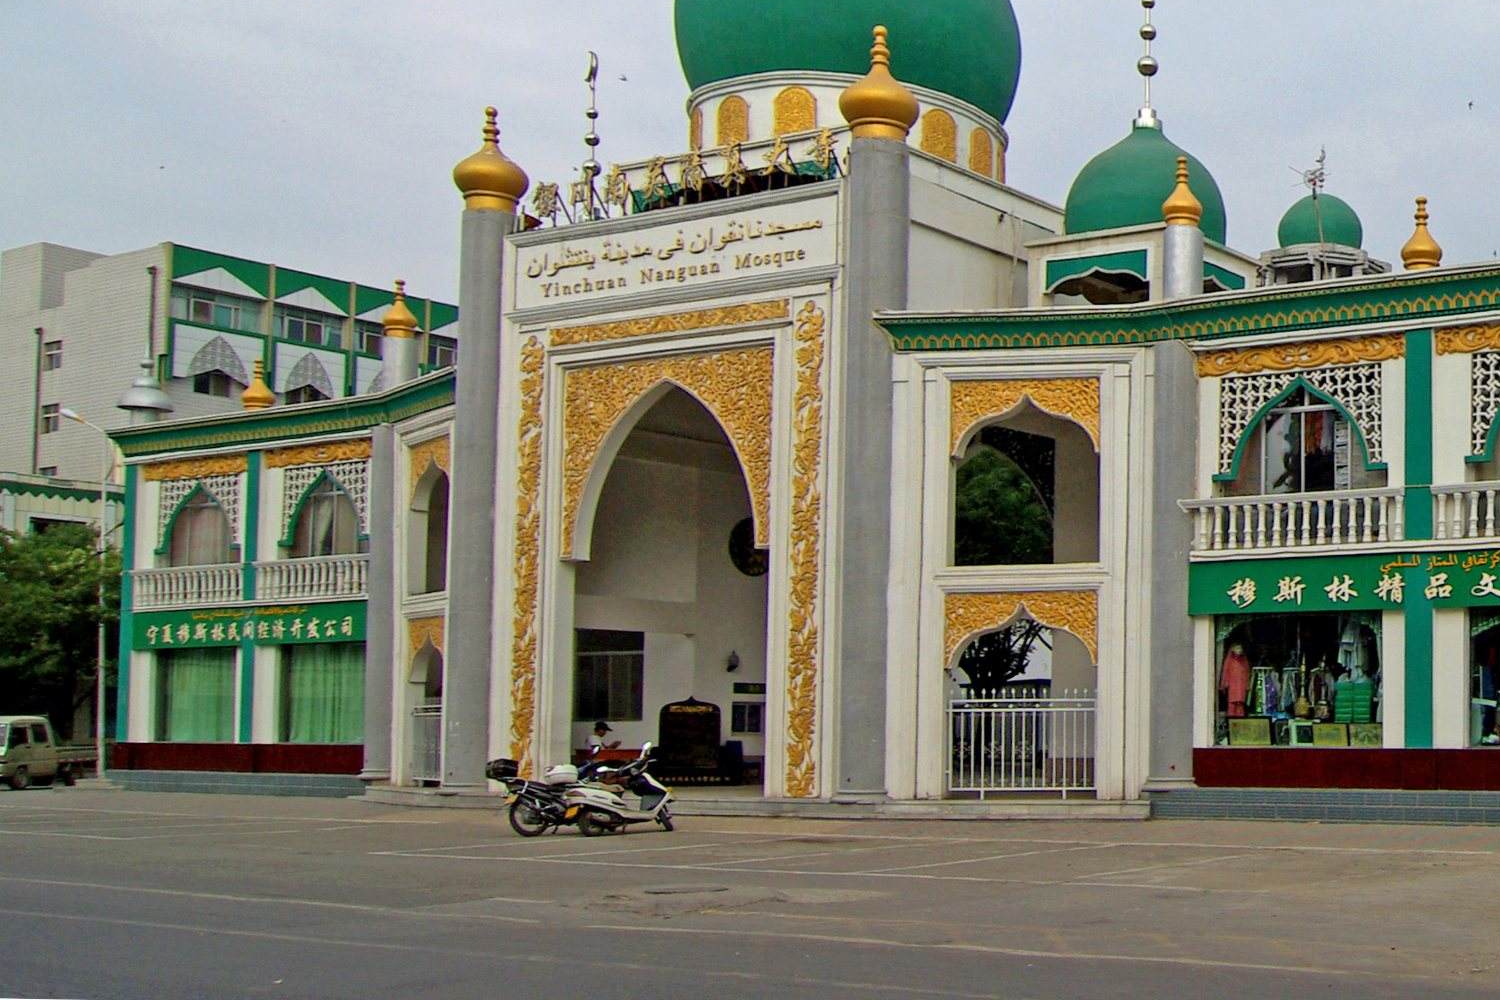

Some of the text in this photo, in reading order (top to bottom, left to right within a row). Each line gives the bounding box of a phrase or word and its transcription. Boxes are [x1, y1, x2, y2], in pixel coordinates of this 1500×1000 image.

[540, 248, 806, 298] Yinchuan Nanguan Mosque
